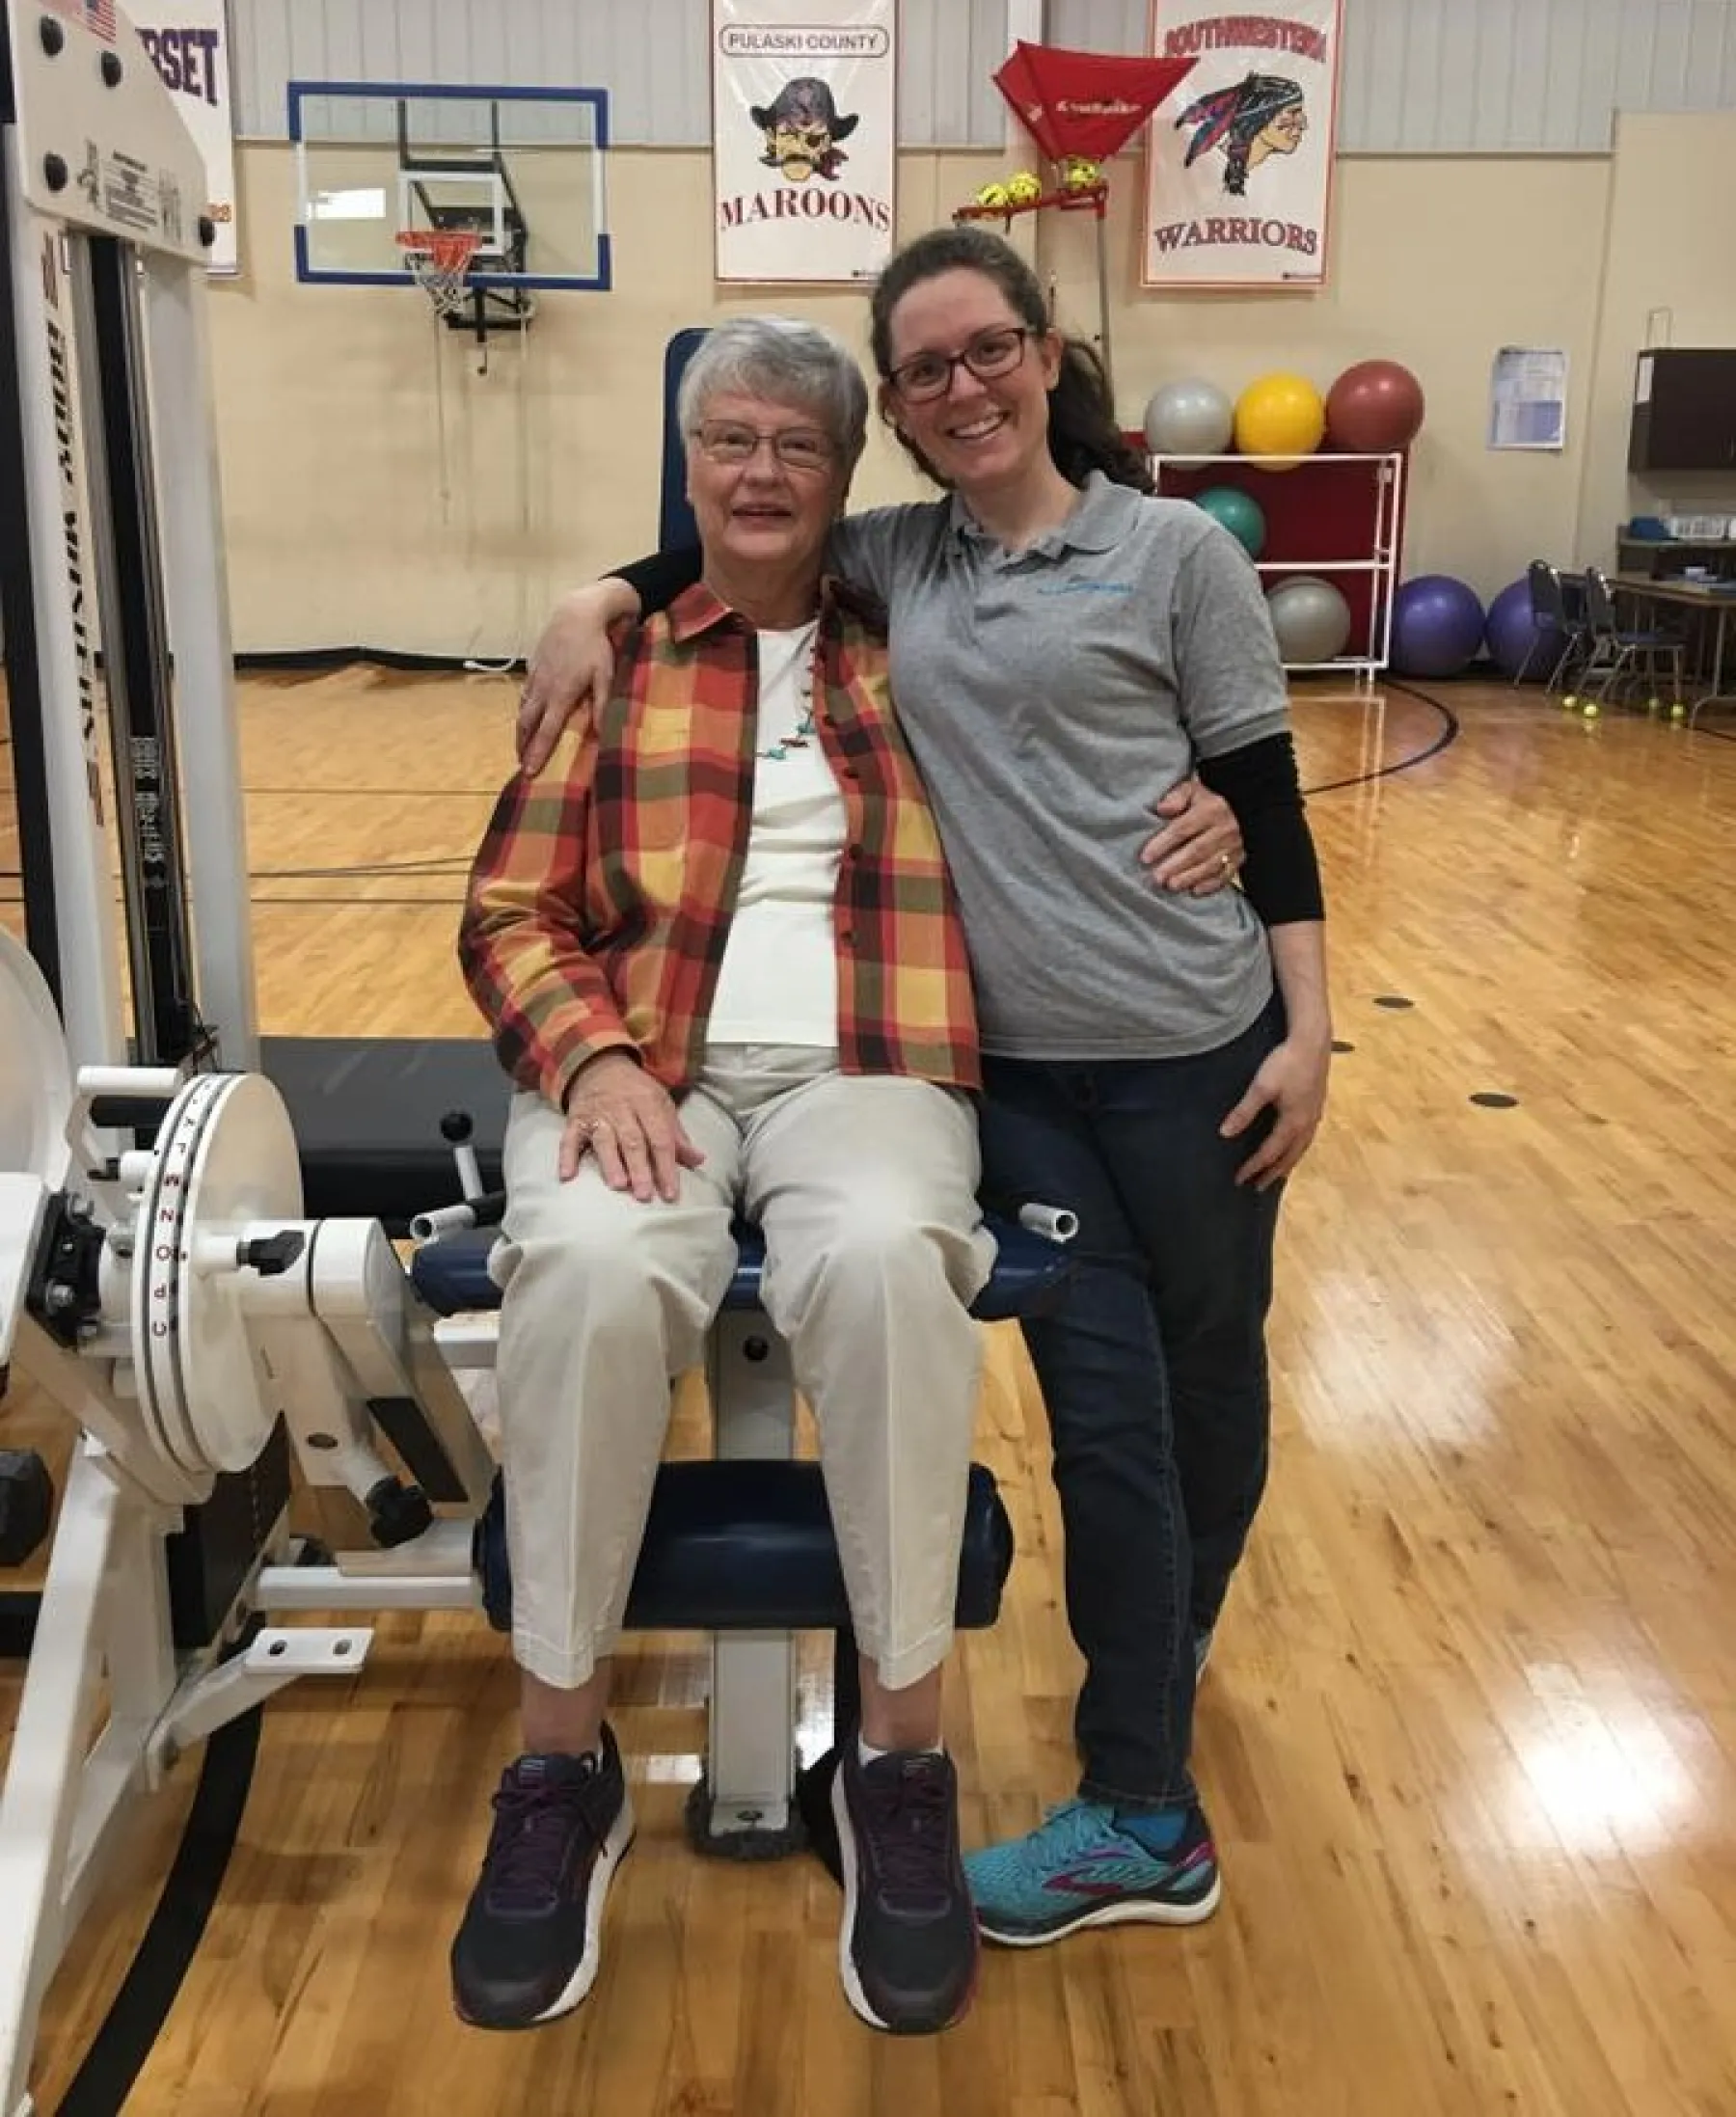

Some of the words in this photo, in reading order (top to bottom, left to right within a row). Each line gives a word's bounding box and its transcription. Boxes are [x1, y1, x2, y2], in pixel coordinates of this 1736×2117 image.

[729, 33, 802, 49] PULASKI
[805, 33, 879, 50] COUNTY
[720, 187, 890, 232] MAROONS
[1154, 217, 1317, 256] WARRIORS
